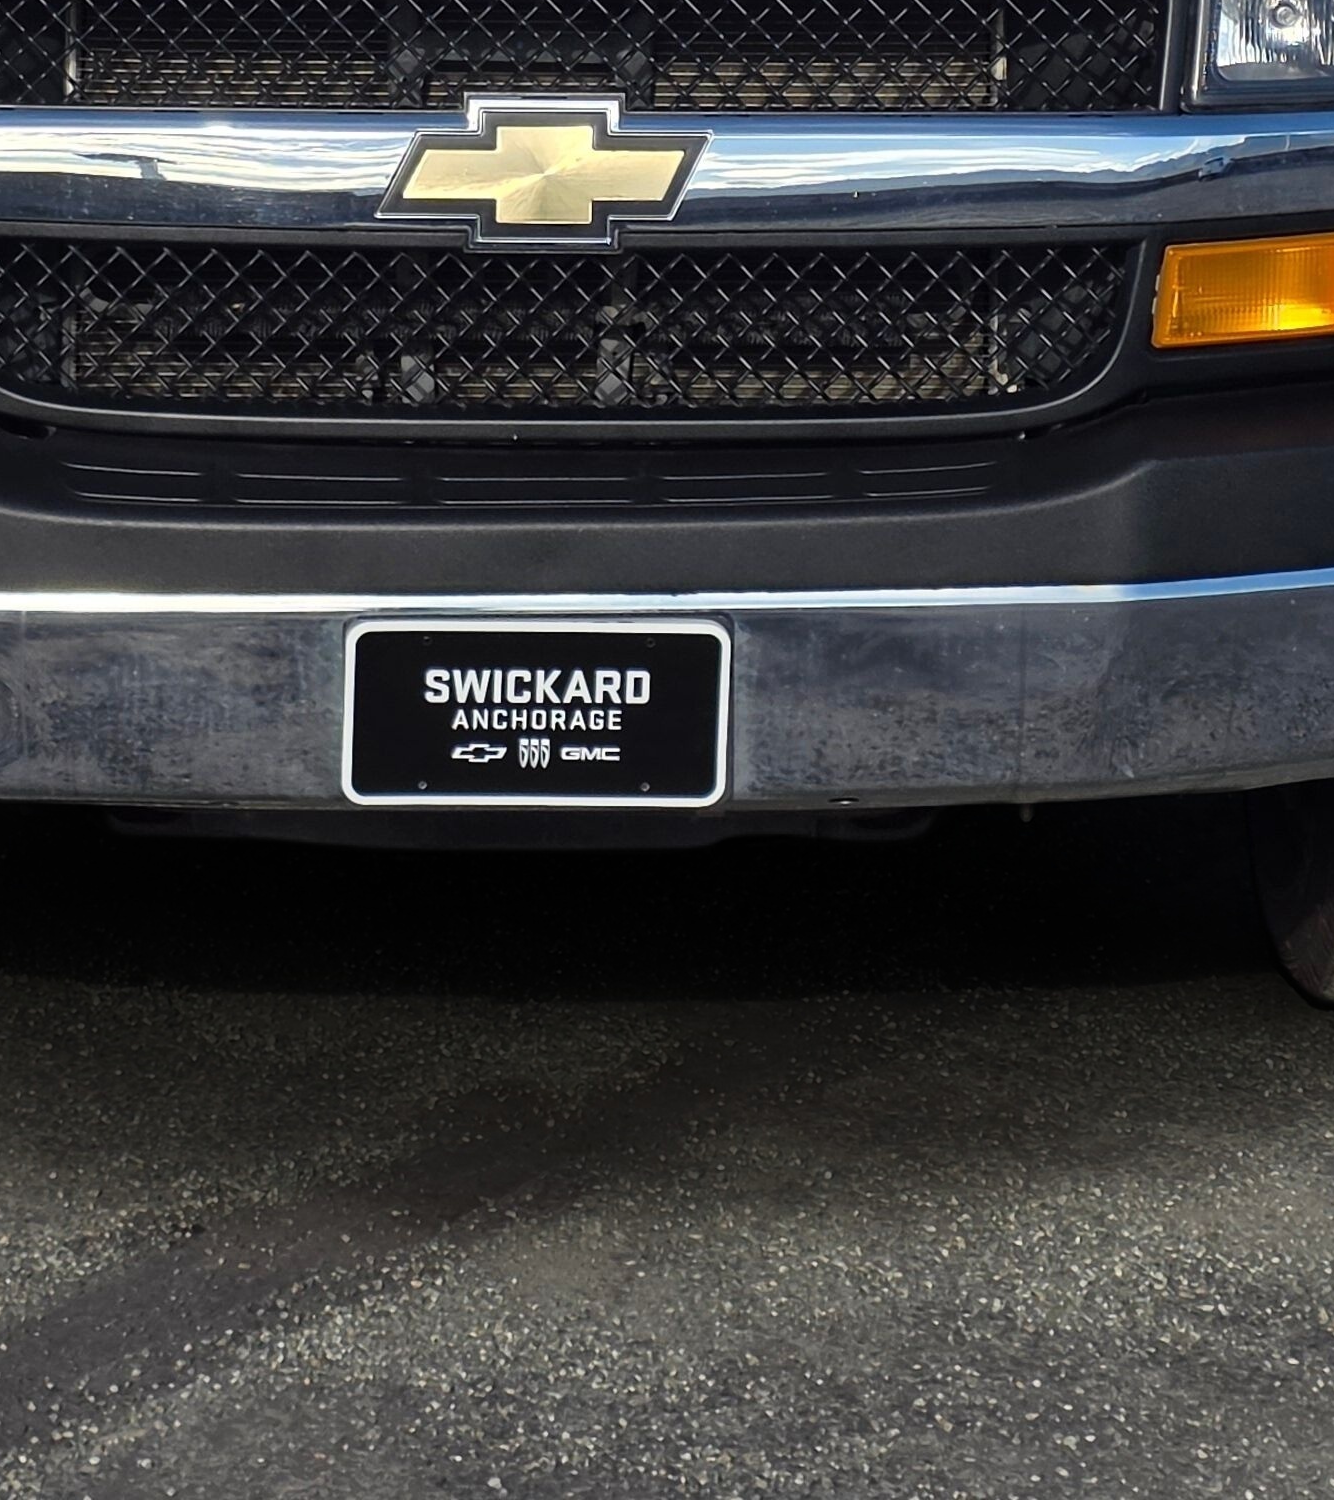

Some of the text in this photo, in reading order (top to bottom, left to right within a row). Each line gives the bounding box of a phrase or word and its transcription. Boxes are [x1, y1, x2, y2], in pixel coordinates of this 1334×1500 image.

[424, 668, 651, 704] SWICKARD
[451, 708, 622, 730] ANCHORAGE
[560, 746, 621, 761] GMC
